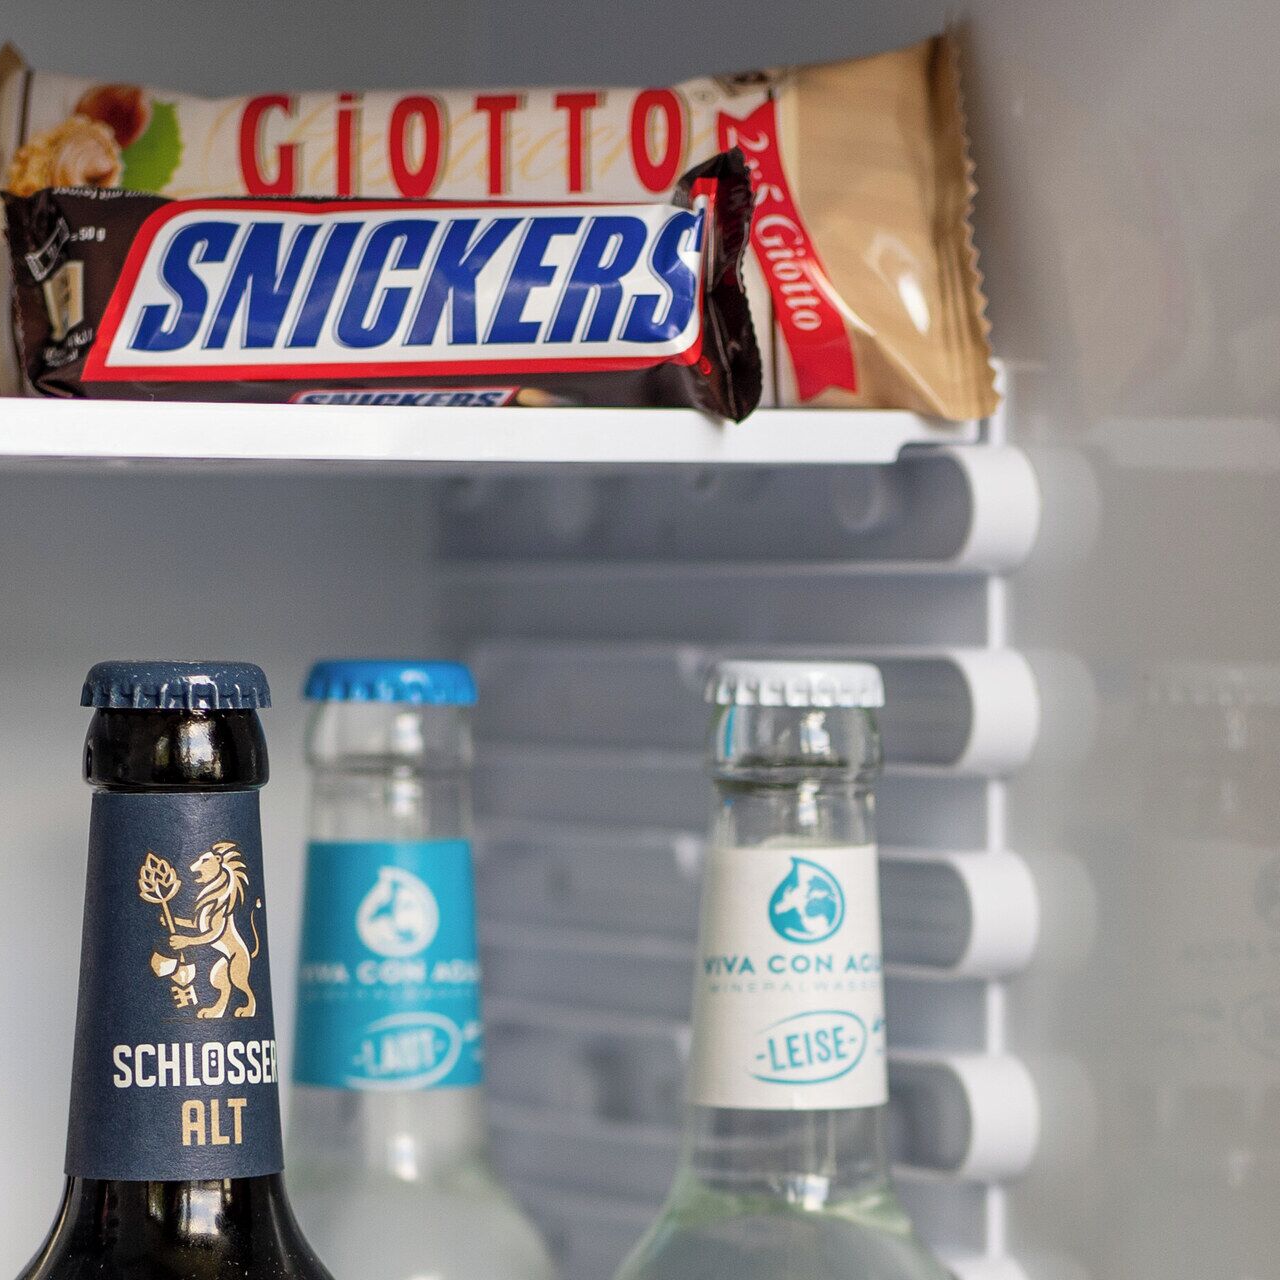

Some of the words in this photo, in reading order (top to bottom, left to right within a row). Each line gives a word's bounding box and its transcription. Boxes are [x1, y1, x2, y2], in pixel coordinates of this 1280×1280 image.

[125, 207, 705, 353] SNICKERS
[754, 214, 823, 331] Giotto
[767, 954, 833, 974] CON
[181, 1097, 248, 1146] ALT
